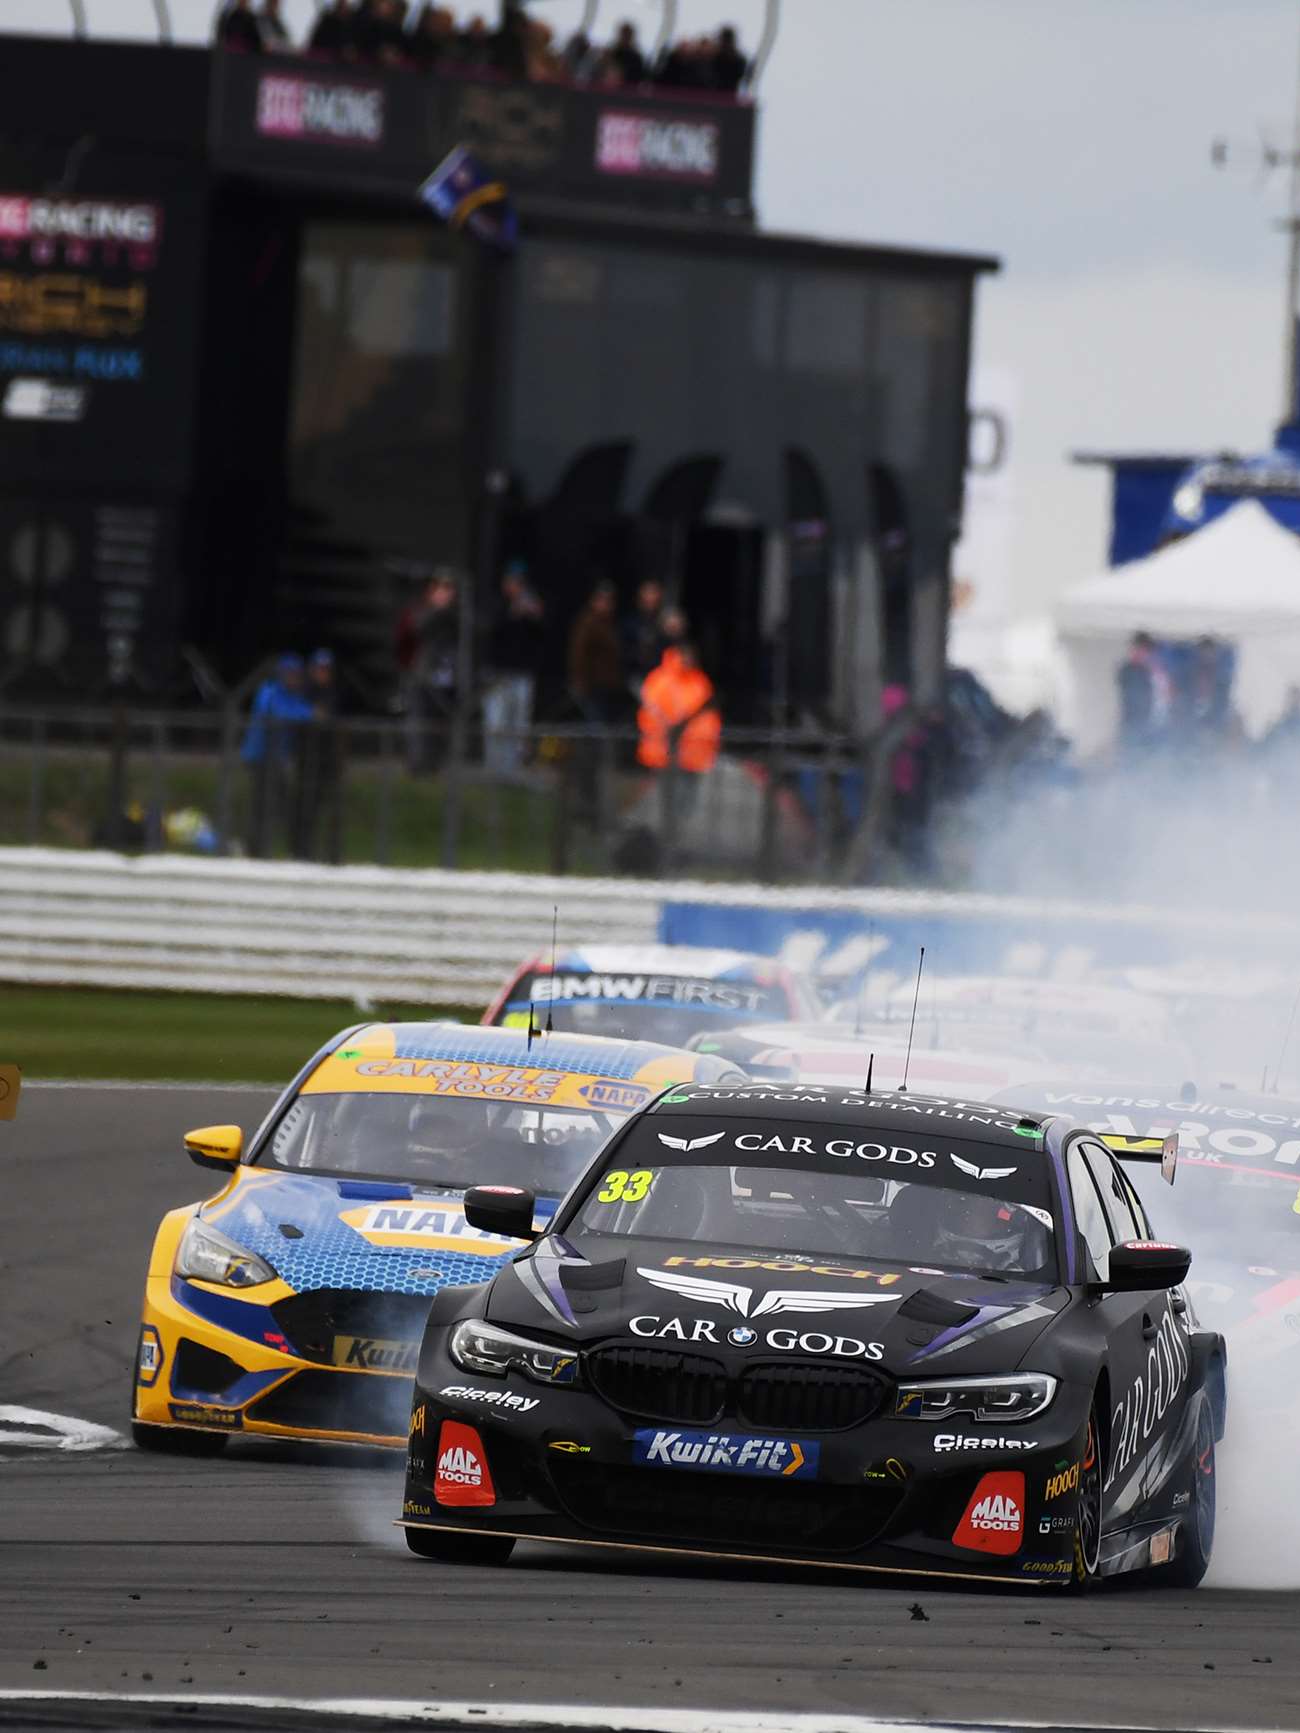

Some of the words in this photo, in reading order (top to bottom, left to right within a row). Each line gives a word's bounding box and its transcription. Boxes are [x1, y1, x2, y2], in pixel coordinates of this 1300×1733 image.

[356, 1059, 564, 1086] CARLYLE
[434, 1079, 557, 1101] TOOLS
[590, 1085, 647, 1106] NAPA
[689, 1091, 827, 1104] CUSTOM
[734, 1133, 817, 1156] CAR
[825, 1140, 937, 1169] GODS
[1185, 1149, 1222, 1164] UK
[597, 1169, 653, 1203] 33
[663, 1255, 902, 1286] HOOCH
[628, 1315, 720, 1343] CAR
[765, 1327, 886, 1362] GODS
[438, 1447, 482, 1476] MAC
[645, 1431, 788, 1471] KwikFit
[438, 1470, 481, 1486] TOOLS
[1044, 1461, 1080, 1501] HOOCH
[971, 1494, 1021, 1521] MAC
[970, 1519, 1020, 1532] TOOLS
